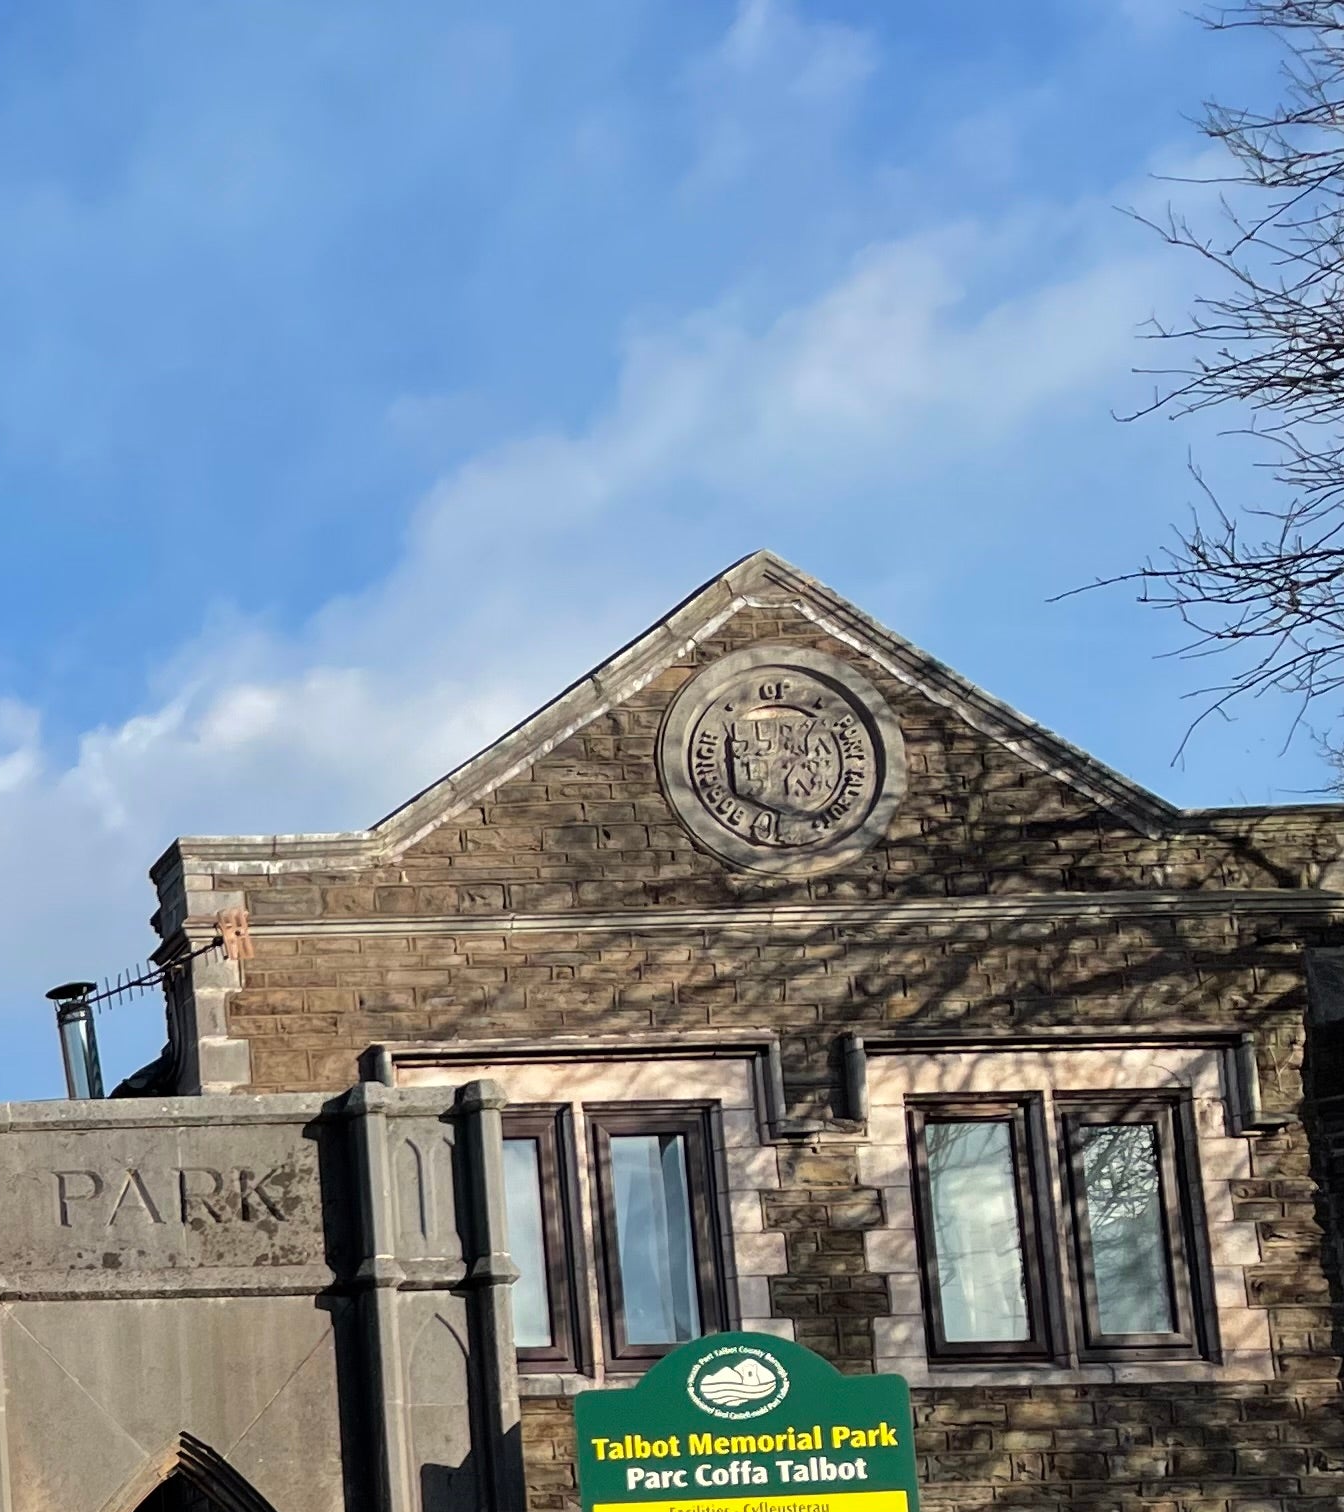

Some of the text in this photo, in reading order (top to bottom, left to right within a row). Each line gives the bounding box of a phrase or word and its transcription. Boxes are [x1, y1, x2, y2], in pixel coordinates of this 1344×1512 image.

[52, 1164, 290, 1228] PARK
[698, 1353, 714, 1365] Port
[713, 1346, 738, 1356] Talbot
[738, 1345, 765, 1358] County
[592, 1422, 899, 1461] Talbot Memorial Park
[627, 1456, 868, 1490] Parc Coffa Talbot
